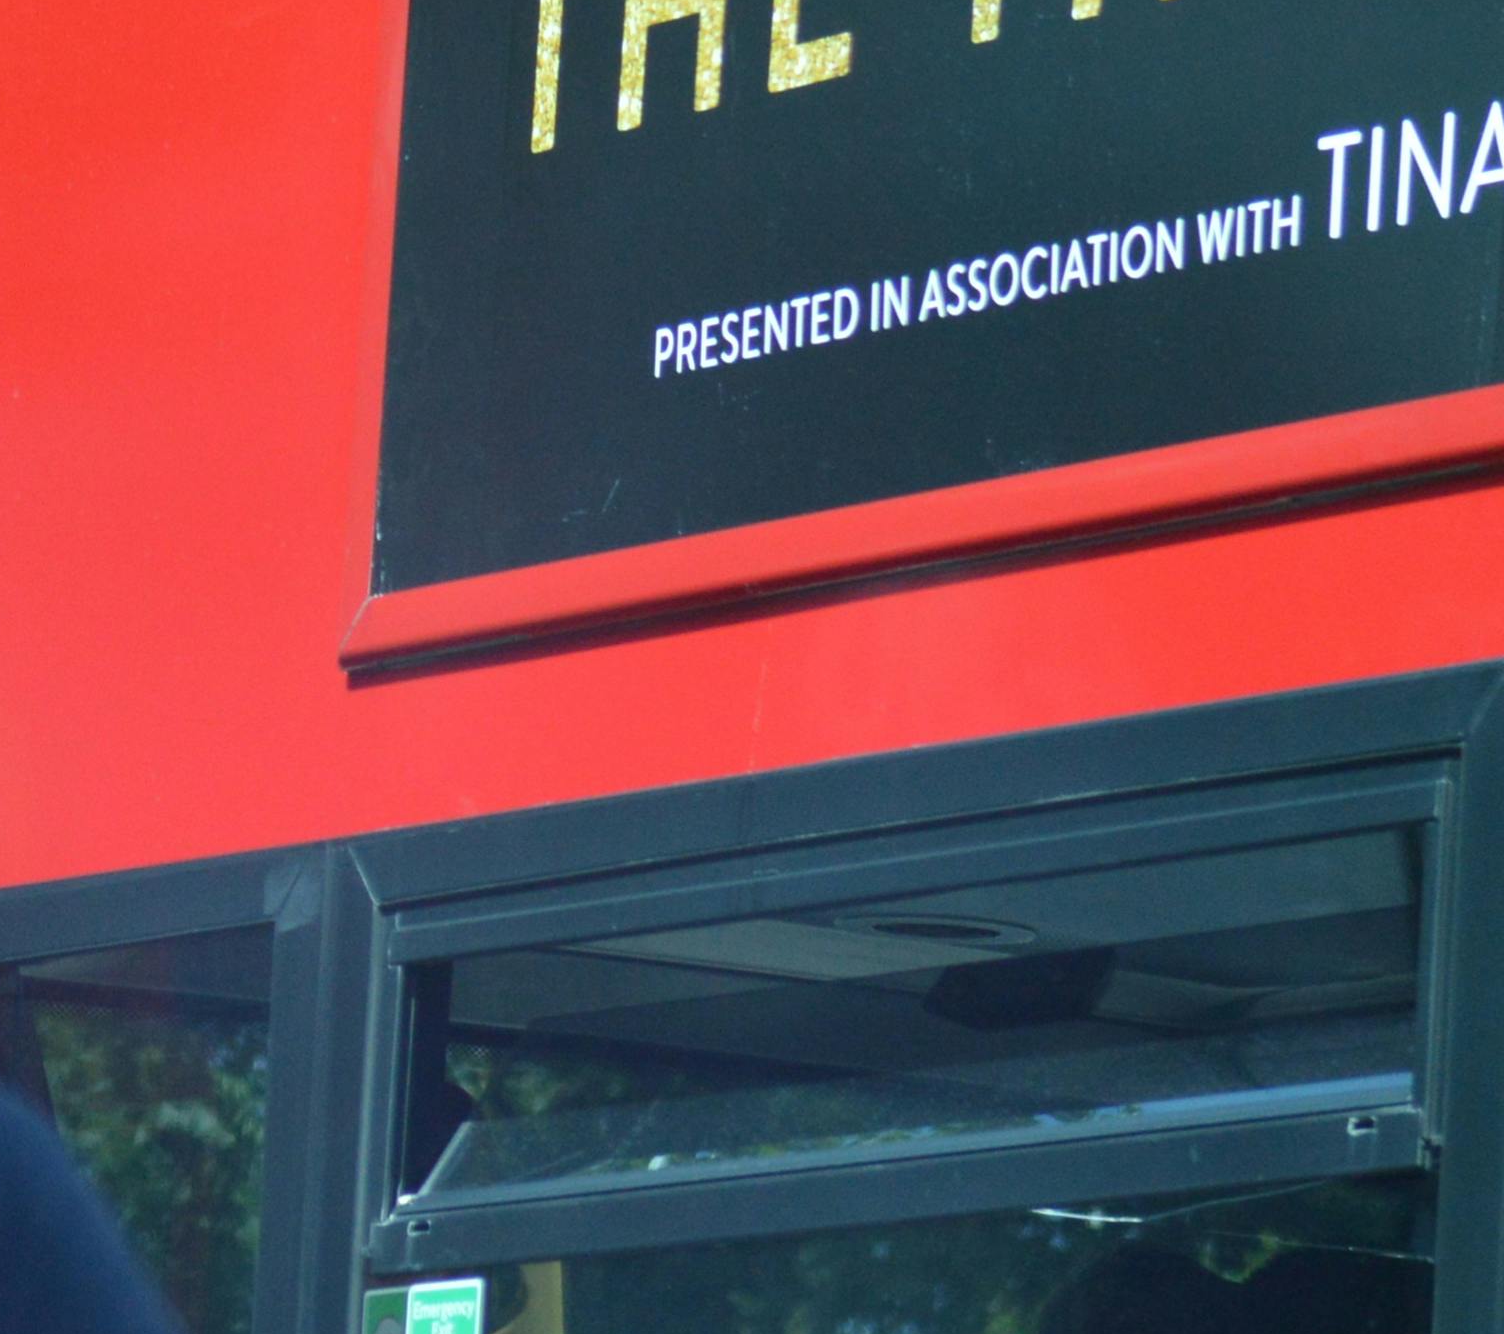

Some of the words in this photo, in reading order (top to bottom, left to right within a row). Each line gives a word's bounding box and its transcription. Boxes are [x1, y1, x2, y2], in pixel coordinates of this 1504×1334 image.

[653, 286, 860, 378] PRESENTED
[869, 277, 911, 332] IN
[918, 217, 1184, 322] ASSOCIATION
[1197, 194, 1302, 265] WITH
